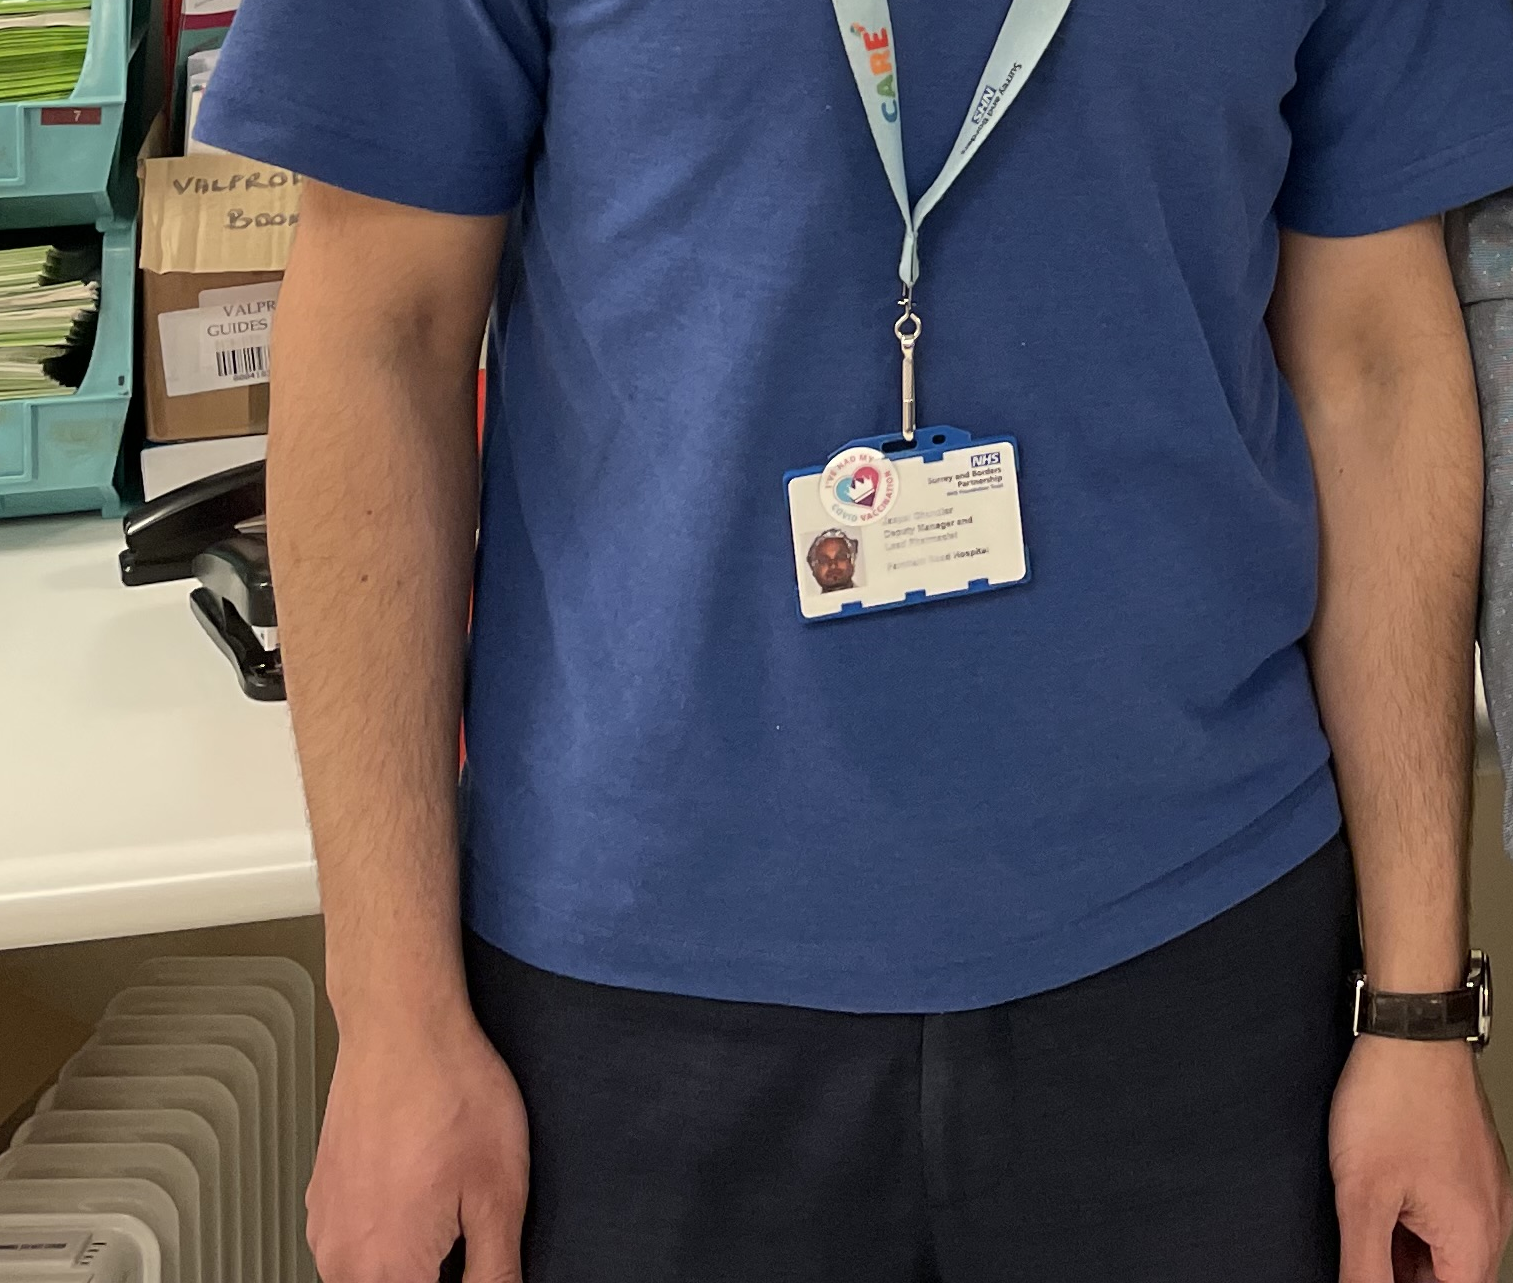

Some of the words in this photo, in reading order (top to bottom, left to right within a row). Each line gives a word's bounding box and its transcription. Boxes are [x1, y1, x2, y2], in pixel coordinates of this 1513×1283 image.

[863, 26, 898, 123] CARE
[999, 61, 1023, 96] Surrey
[973, 86, 997, 124] NHS
[986, 96, 1000, 117] and
[223, 299, 276, 317] VALPR
[206, 318, 268, 337] GUIDES
[971, 452, 1001, 468] NHS
[955, 471, 970, 480] and
[971, 466, 1002, 477] Borders
[957, 475, 1003, 488] Partnership
